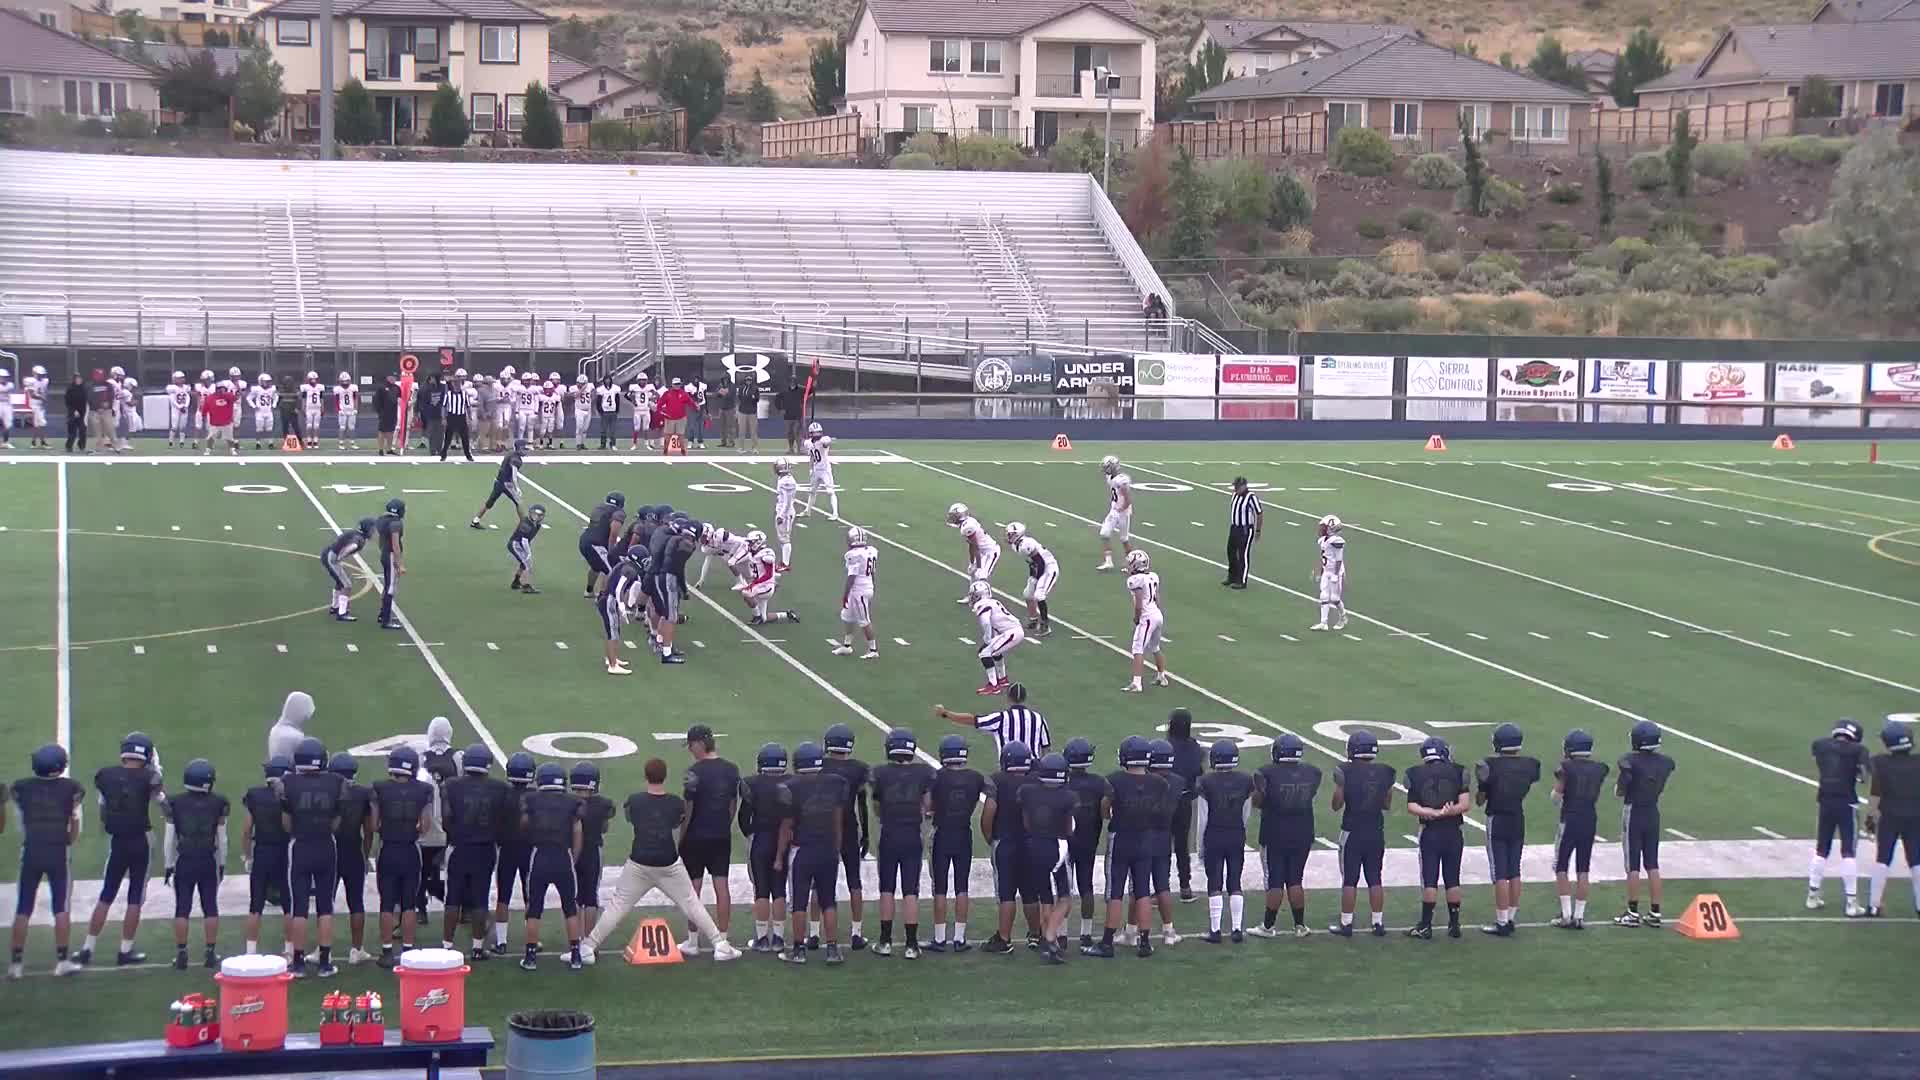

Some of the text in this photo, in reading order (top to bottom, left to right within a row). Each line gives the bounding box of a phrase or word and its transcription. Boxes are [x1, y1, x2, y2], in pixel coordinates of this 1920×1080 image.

[440, 350, 453, 365] 3
[1064, 363, 1124, 374] UNDER
[1439, 362, 1470, 375] SIERRA
[1014, 373, 1051, 382] DRHS
[1056, 376, 1133, 388] ARMUR
[1438, 377, 1483, 391] CONTROLS
[260, 396, 271, 406] 53
[311, 393, 317, 404] 6
[344, 393, 350, 406] 8
[606, 395, 612, 406] 4
[640, 392, 646, 404] 9
[543, 402, 554, 413] 23
[287, 438, 297, 448] 40
[1058, 437, 1067, 447] 20
[1432, 437, 1442, 448] 10
[1699, 901, 1727, 932] 30
[642, 925, 670, 956] 40
